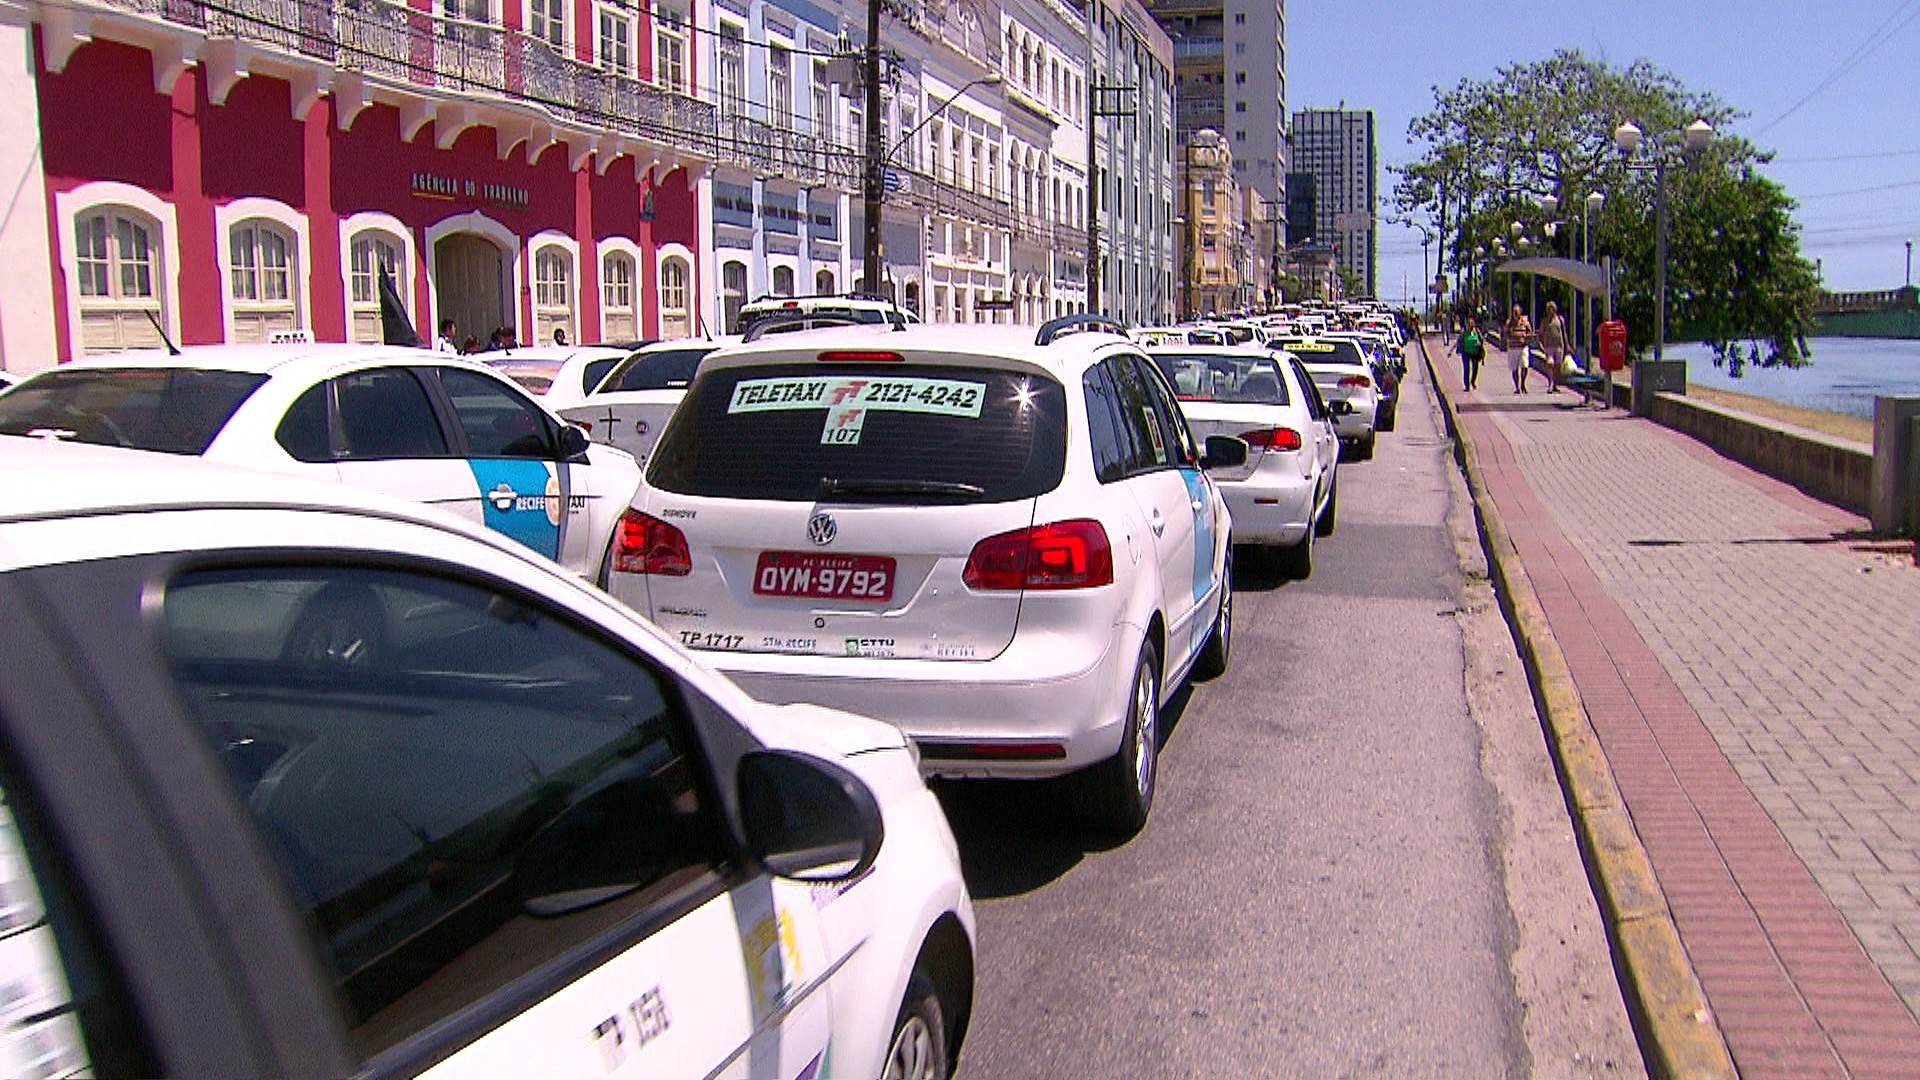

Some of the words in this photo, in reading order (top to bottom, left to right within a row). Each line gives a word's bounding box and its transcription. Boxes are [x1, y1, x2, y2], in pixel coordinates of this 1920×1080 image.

[412, 172, 458, 195] AGÊNCIA
[465, 179, 476, 196] DO
[484, 184, 529, 205] TRABALHO
[736, 382, 827, 406] TELETAXI
[865, 382, 978, 408] 2121-4242
[826, 428, 860, 442] 107
[515, 497, 545, 511] RECIFE
[820, 558, 853, 568] RECIFE
[680, 631, 701, 645] TP
[704, 633, 744, 649] 1717
[786, 639, 817, 649] RECIFE
